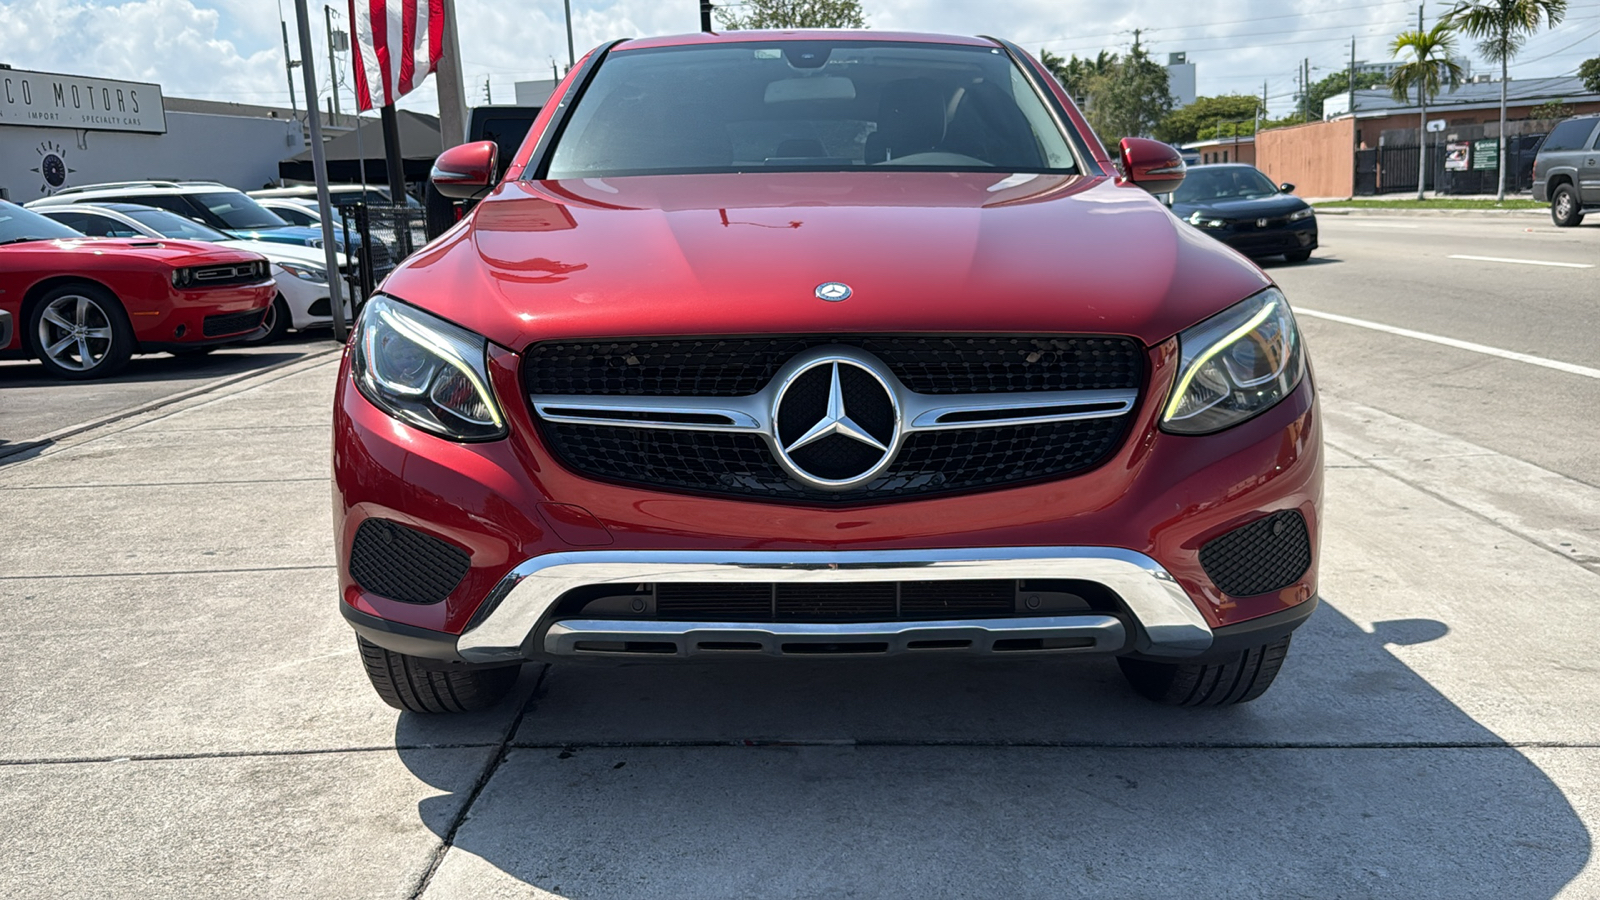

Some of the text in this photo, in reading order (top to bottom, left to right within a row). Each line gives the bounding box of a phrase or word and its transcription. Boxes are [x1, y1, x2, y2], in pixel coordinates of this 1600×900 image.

[53, 82, 139, 113] MOTORS
[28, 112, 59, 120] IMPORT
[82, 115, 120, 124] SPECIALTY
